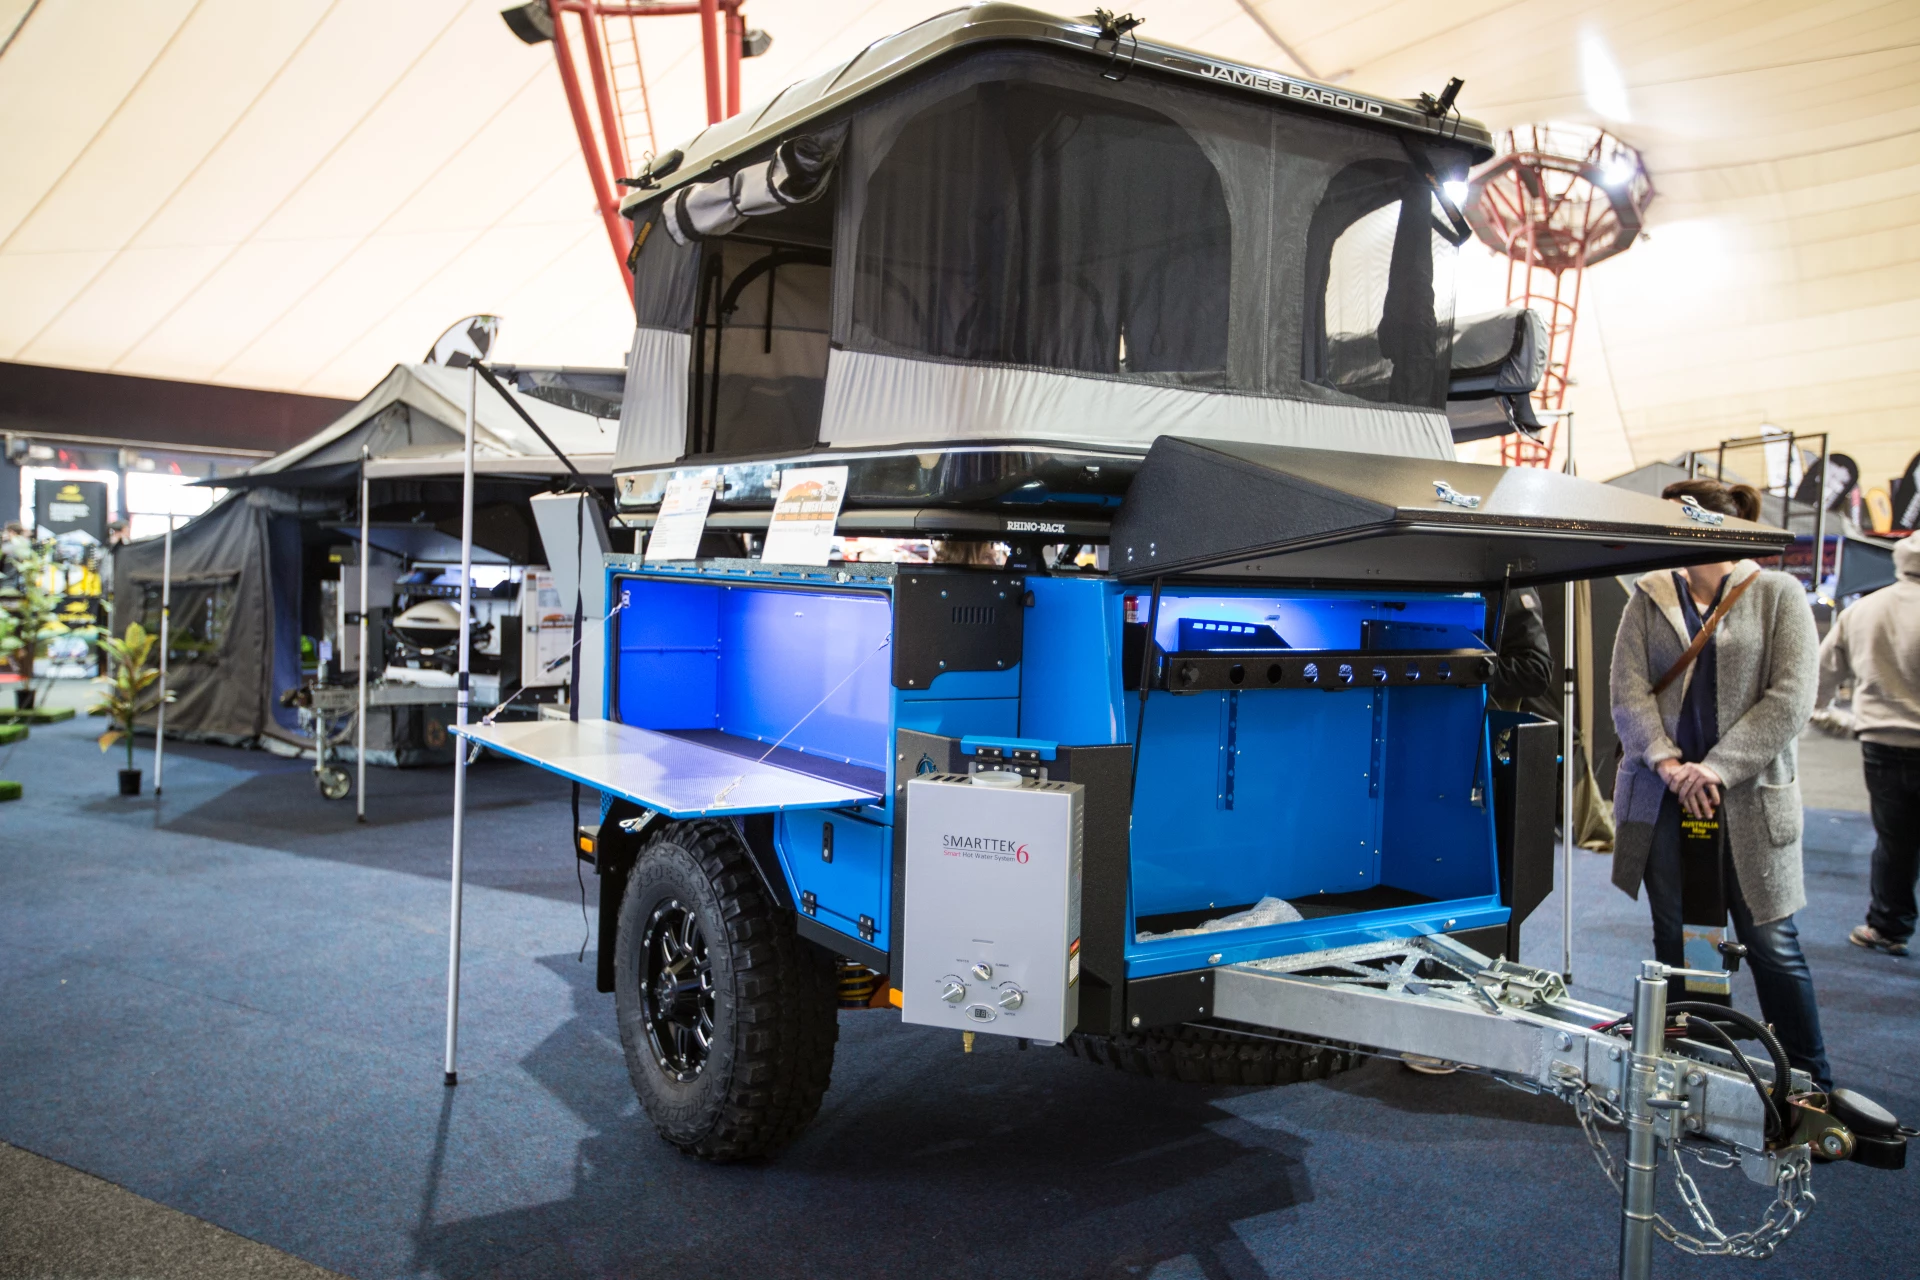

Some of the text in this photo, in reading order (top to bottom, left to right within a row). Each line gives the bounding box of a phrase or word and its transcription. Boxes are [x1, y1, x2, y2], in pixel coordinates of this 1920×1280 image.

[1200, 65, 1383, 116] JAMES BAROUD
[1007, 521, 1065, 533] RHINO-RACK
[1681, 821, 1719, 829] AUSTRALIA
[943, 834, 1029, 864] SMARTTEK 6
[994, 854, 1016, 862] System
